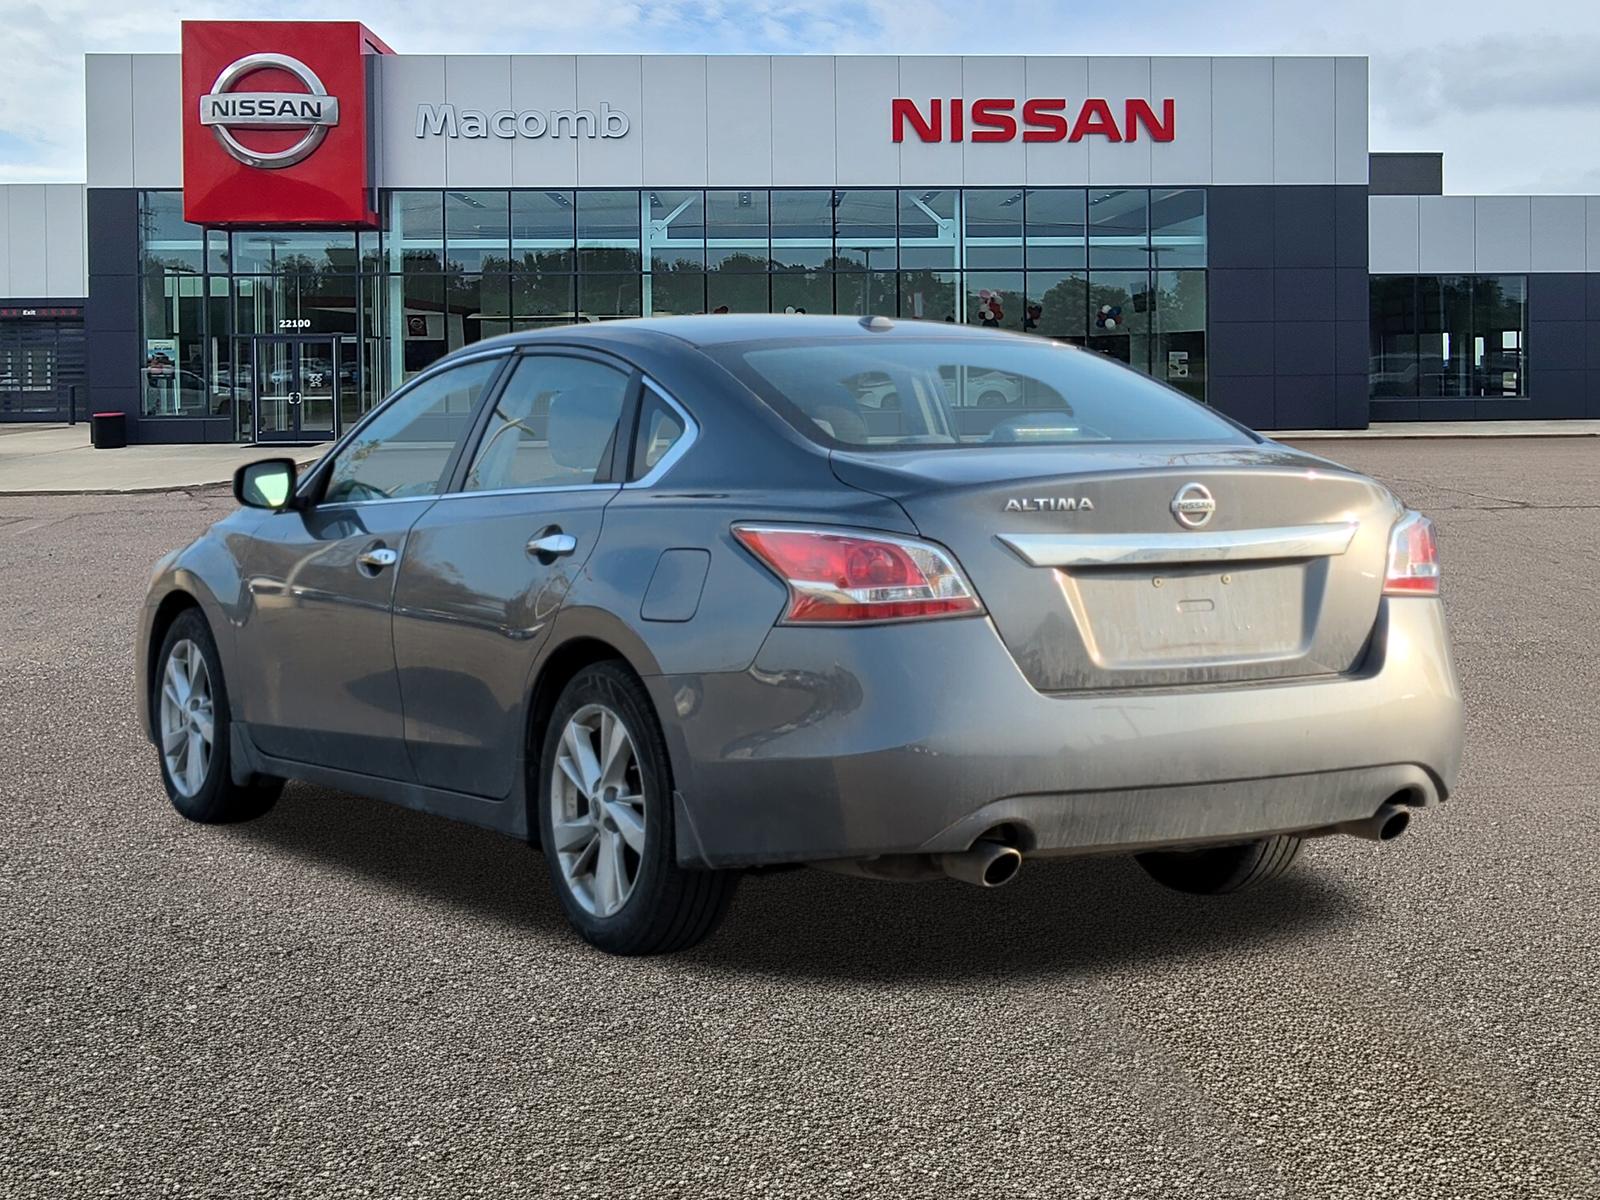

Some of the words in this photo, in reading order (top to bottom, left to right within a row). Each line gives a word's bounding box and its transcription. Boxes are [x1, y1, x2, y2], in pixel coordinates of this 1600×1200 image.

[211, 100, 322, 117] NISSAN
[415, 102, 630, 139] Macomb
[892, 98, 1175, 143] NISSAN
[279, 319, 311, 328] 22100
[1004, 497, 1095, 512] ALTIMA
[1177, 501, 1213, 511] NISSAN
